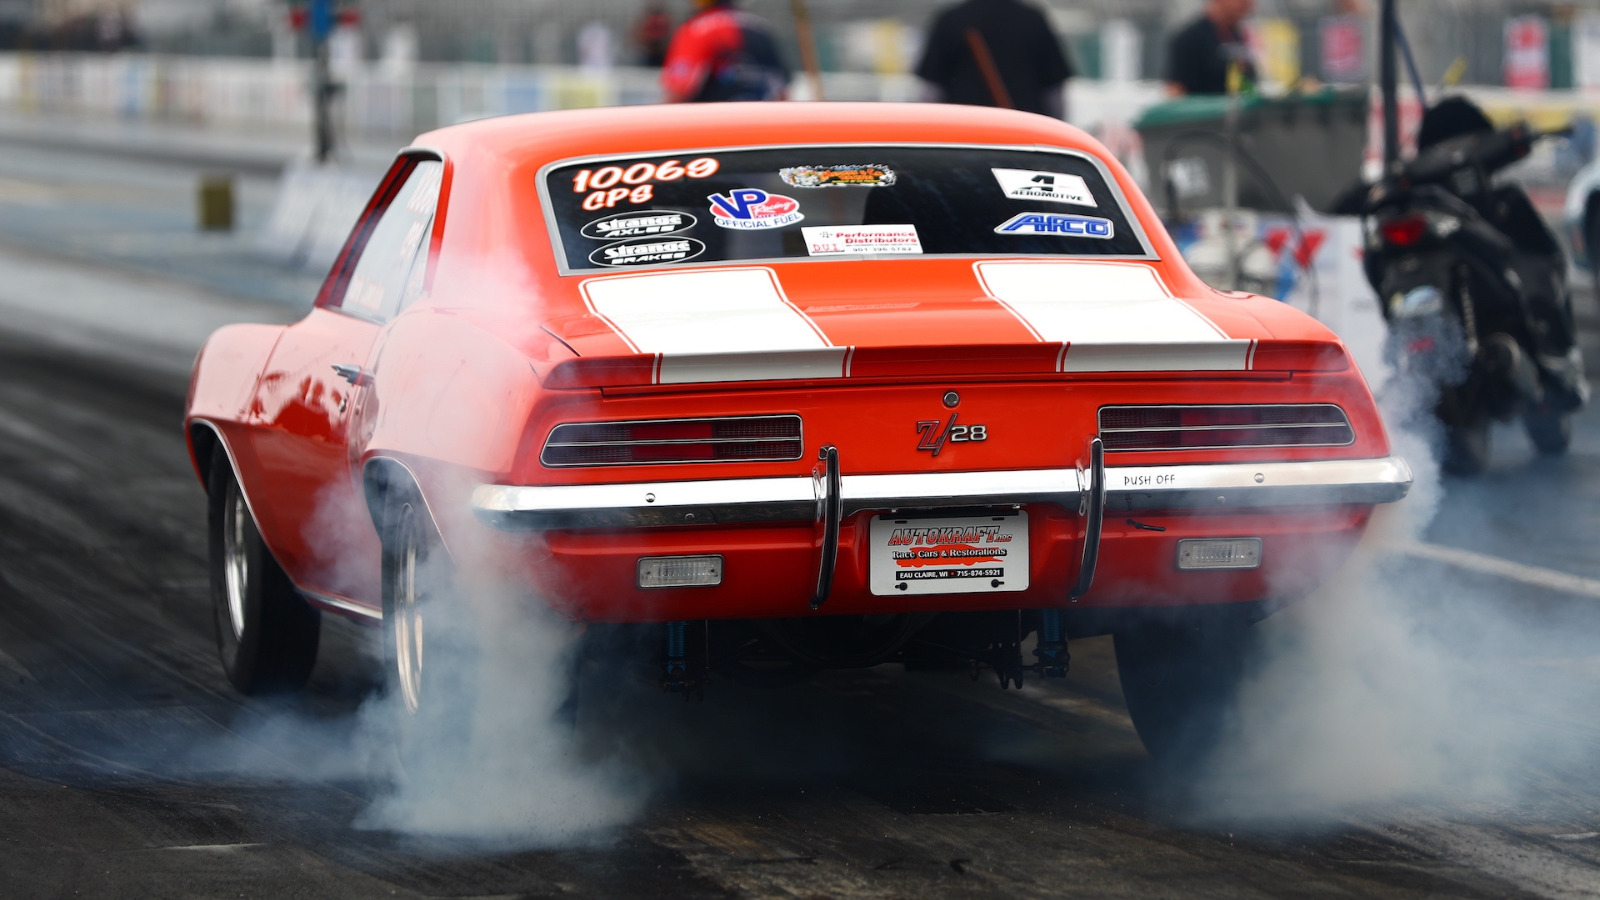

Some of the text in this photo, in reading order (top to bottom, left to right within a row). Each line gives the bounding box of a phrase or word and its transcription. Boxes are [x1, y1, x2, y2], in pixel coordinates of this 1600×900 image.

[572, 157, 720, 193] 10069
[1011, 190, 1083, 201] AEROMOTIVE
[710, 190, 767, 220] VP
[596, 214, 682, 233] Strange
[716, 217, 771, 228] OFFICIAL
[774, 213, 801, 226] FUEL
[604, 240, 691, 259] Strange
[1124, 474, 1176, 485] PUSH OFF
[892, 551, 915, 559] Race
[918, 549, 939, 558] Cars
[950, 548, 1006, 557] Restorations
